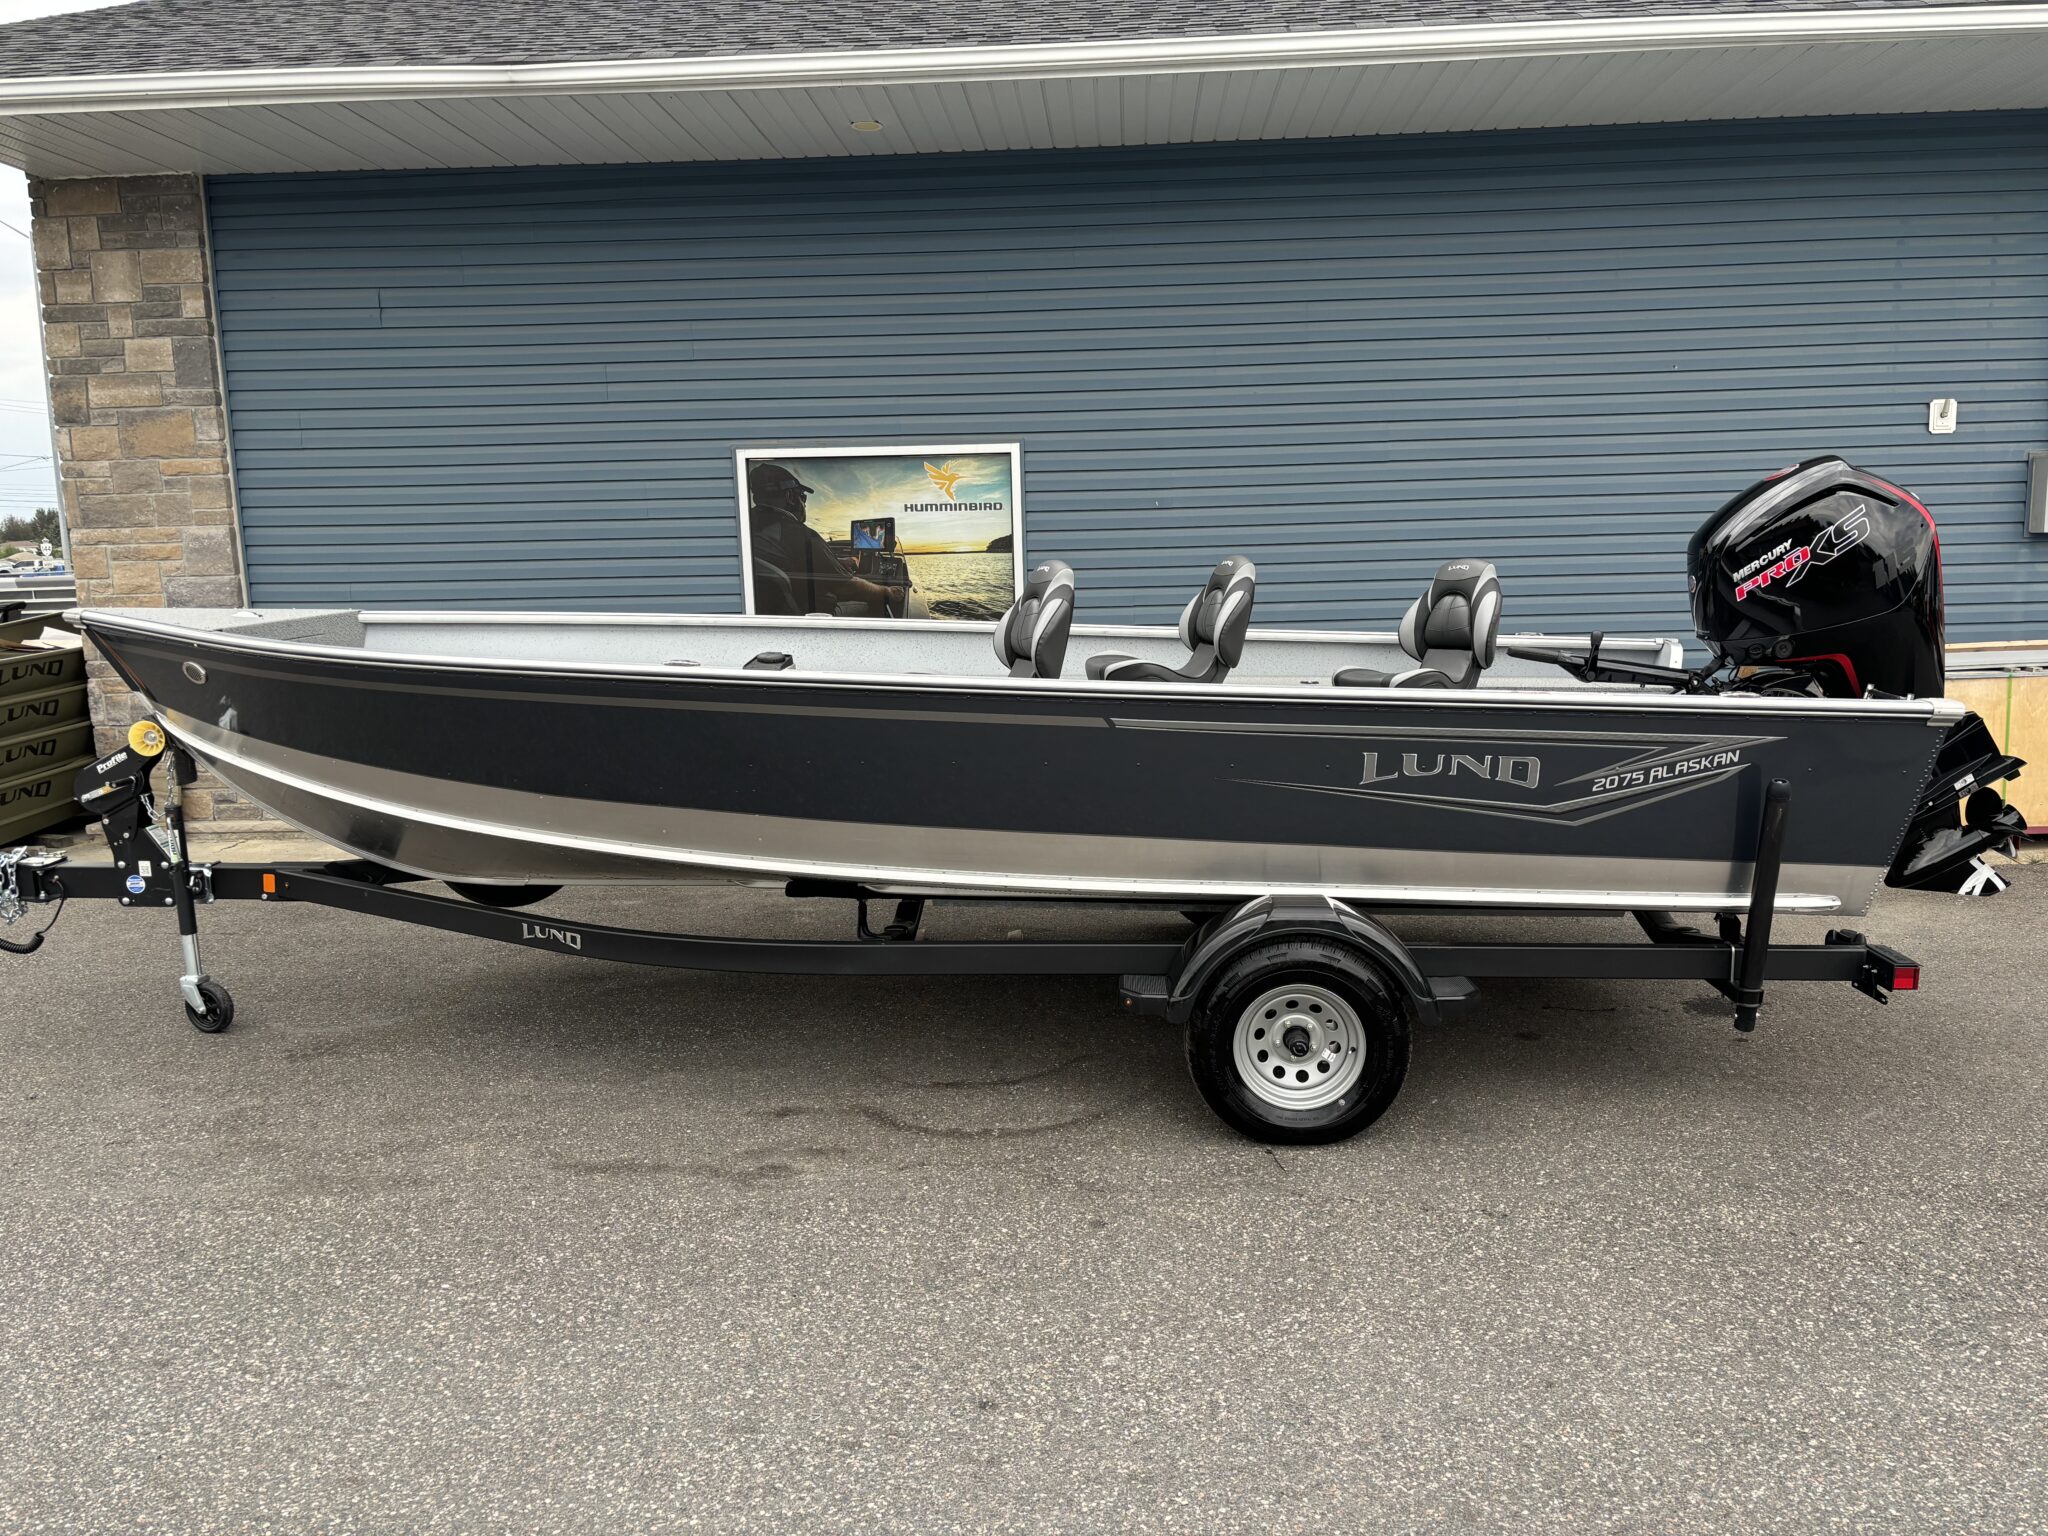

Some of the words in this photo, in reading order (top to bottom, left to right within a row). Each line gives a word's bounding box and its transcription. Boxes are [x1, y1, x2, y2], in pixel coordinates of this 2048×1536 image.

[904, 502, 1003, 512] HUMMINBIRD
[1733, 538, 1793, 583] MERCURY
[0, 738, 57, 766] UND
[96, 751, 128, 774] Profile
[1359, 752, 1541, 789] LUND
[1592, 770, 1644, 792] 2075
[1648, 750, 1741, 785] ALASKAN
[522, 922, 581, 950] LUND
